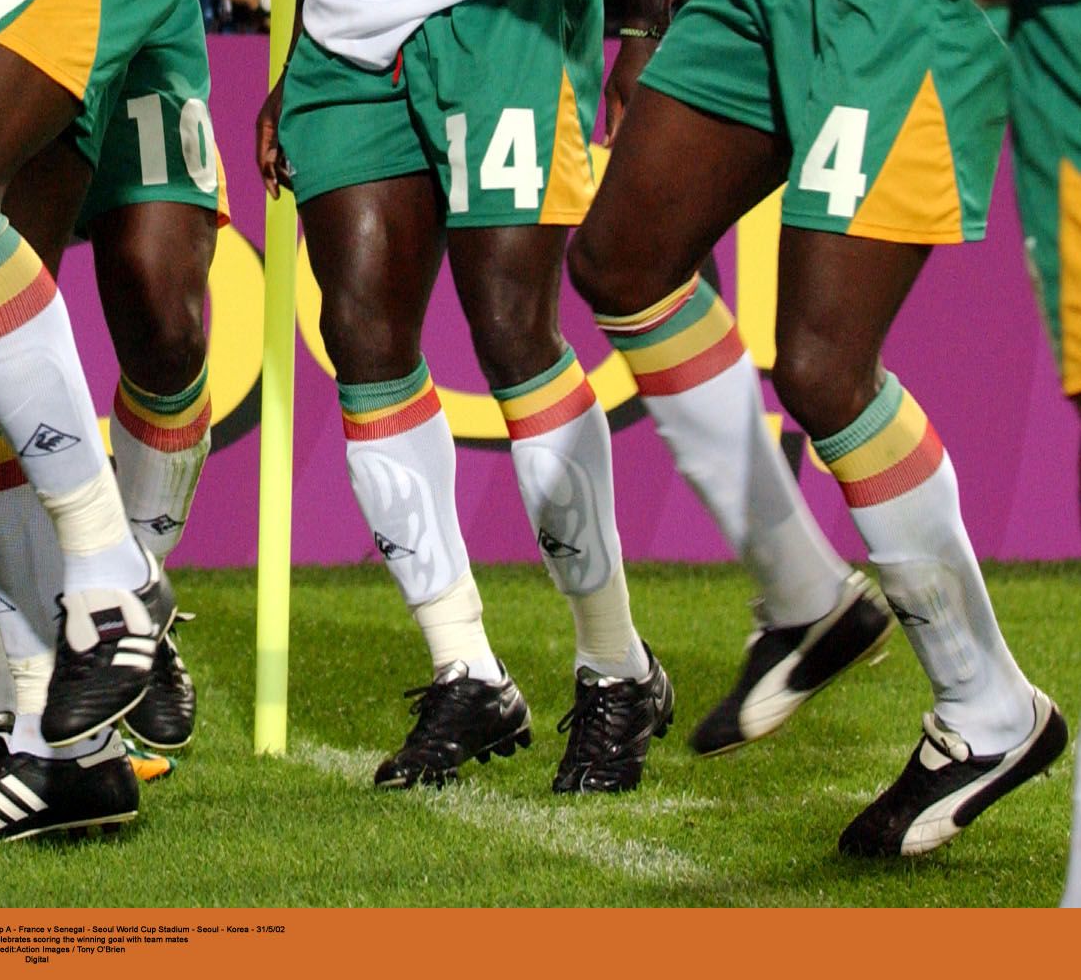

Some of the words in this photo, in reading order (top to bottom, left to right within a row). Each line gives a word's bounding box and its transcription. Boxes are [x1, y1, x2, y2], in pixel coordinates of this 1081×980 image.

[127, 92, 219, 194] 10
[445, 107, 544, 214] 14
[798, 105, 869, 219] 4
